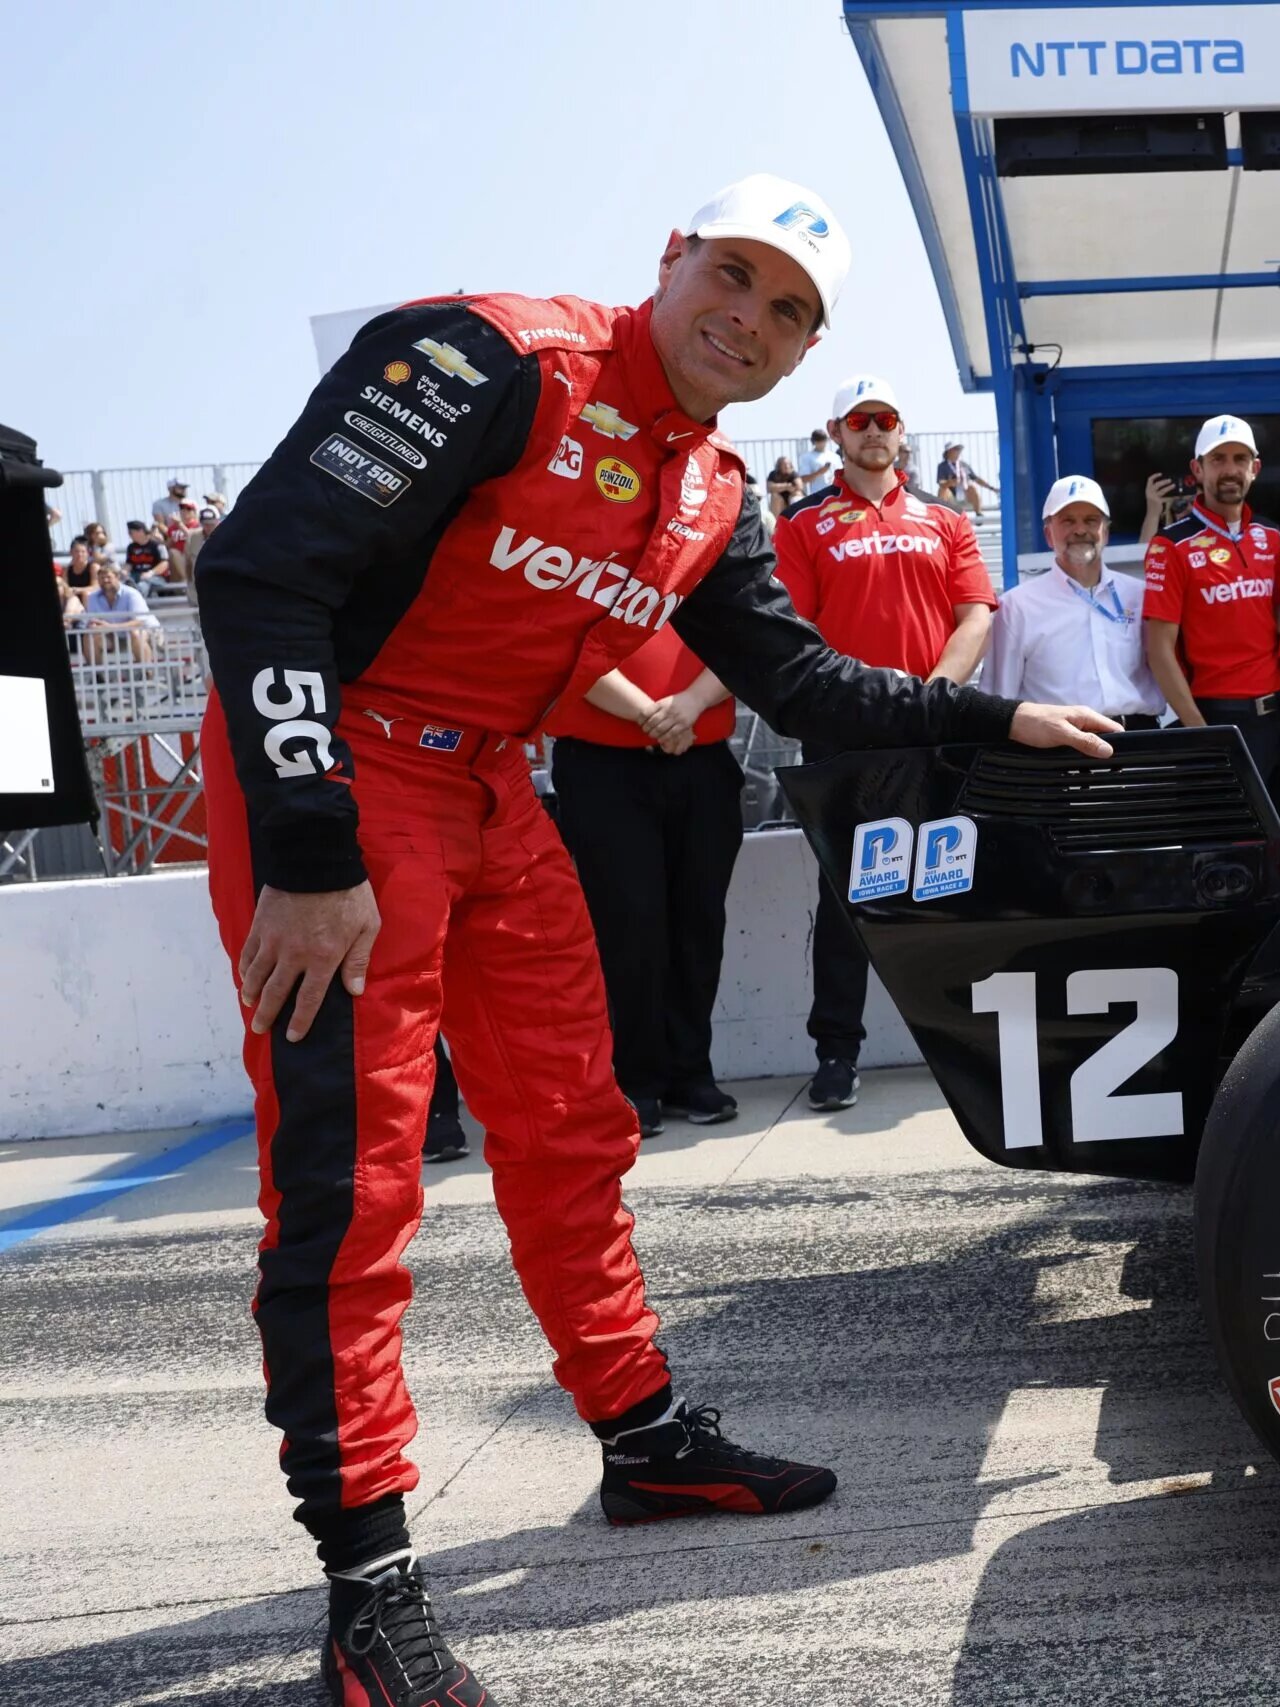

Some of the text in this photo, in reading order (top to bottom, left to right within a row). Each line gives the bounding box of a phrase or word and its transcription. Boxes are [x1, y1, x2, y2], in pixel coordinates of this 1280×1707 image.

[1010, 41, 1106, 78] NTT
[518, 327, 587, 347] Firestone
[416, 381, 463, 417] V-Power
[420, 375, 441, 391] Shell
[360, 385, 447, 448] SIEMENS
[352, 416, 420, 464] FREIGHTLINER
[327, 440, 402, 491] INDY 500
[829, 531, 933, 562] verizon
[489, 525, 684, 631] verizon
[1200, 575, 1274, 604] verizon
[252, 666, 335, 779] 5G
[858, 889, 875, 897] IOWA
[876, 885, 894, 893] RACE
[859, 870, 899, 887] AWARD
[922, 886, 939, 895] IOWA
[940, 883, 957, 891] RACE
[923, 868, 963, 886] AWARD
[971, 966, 1185, 1150] 12
